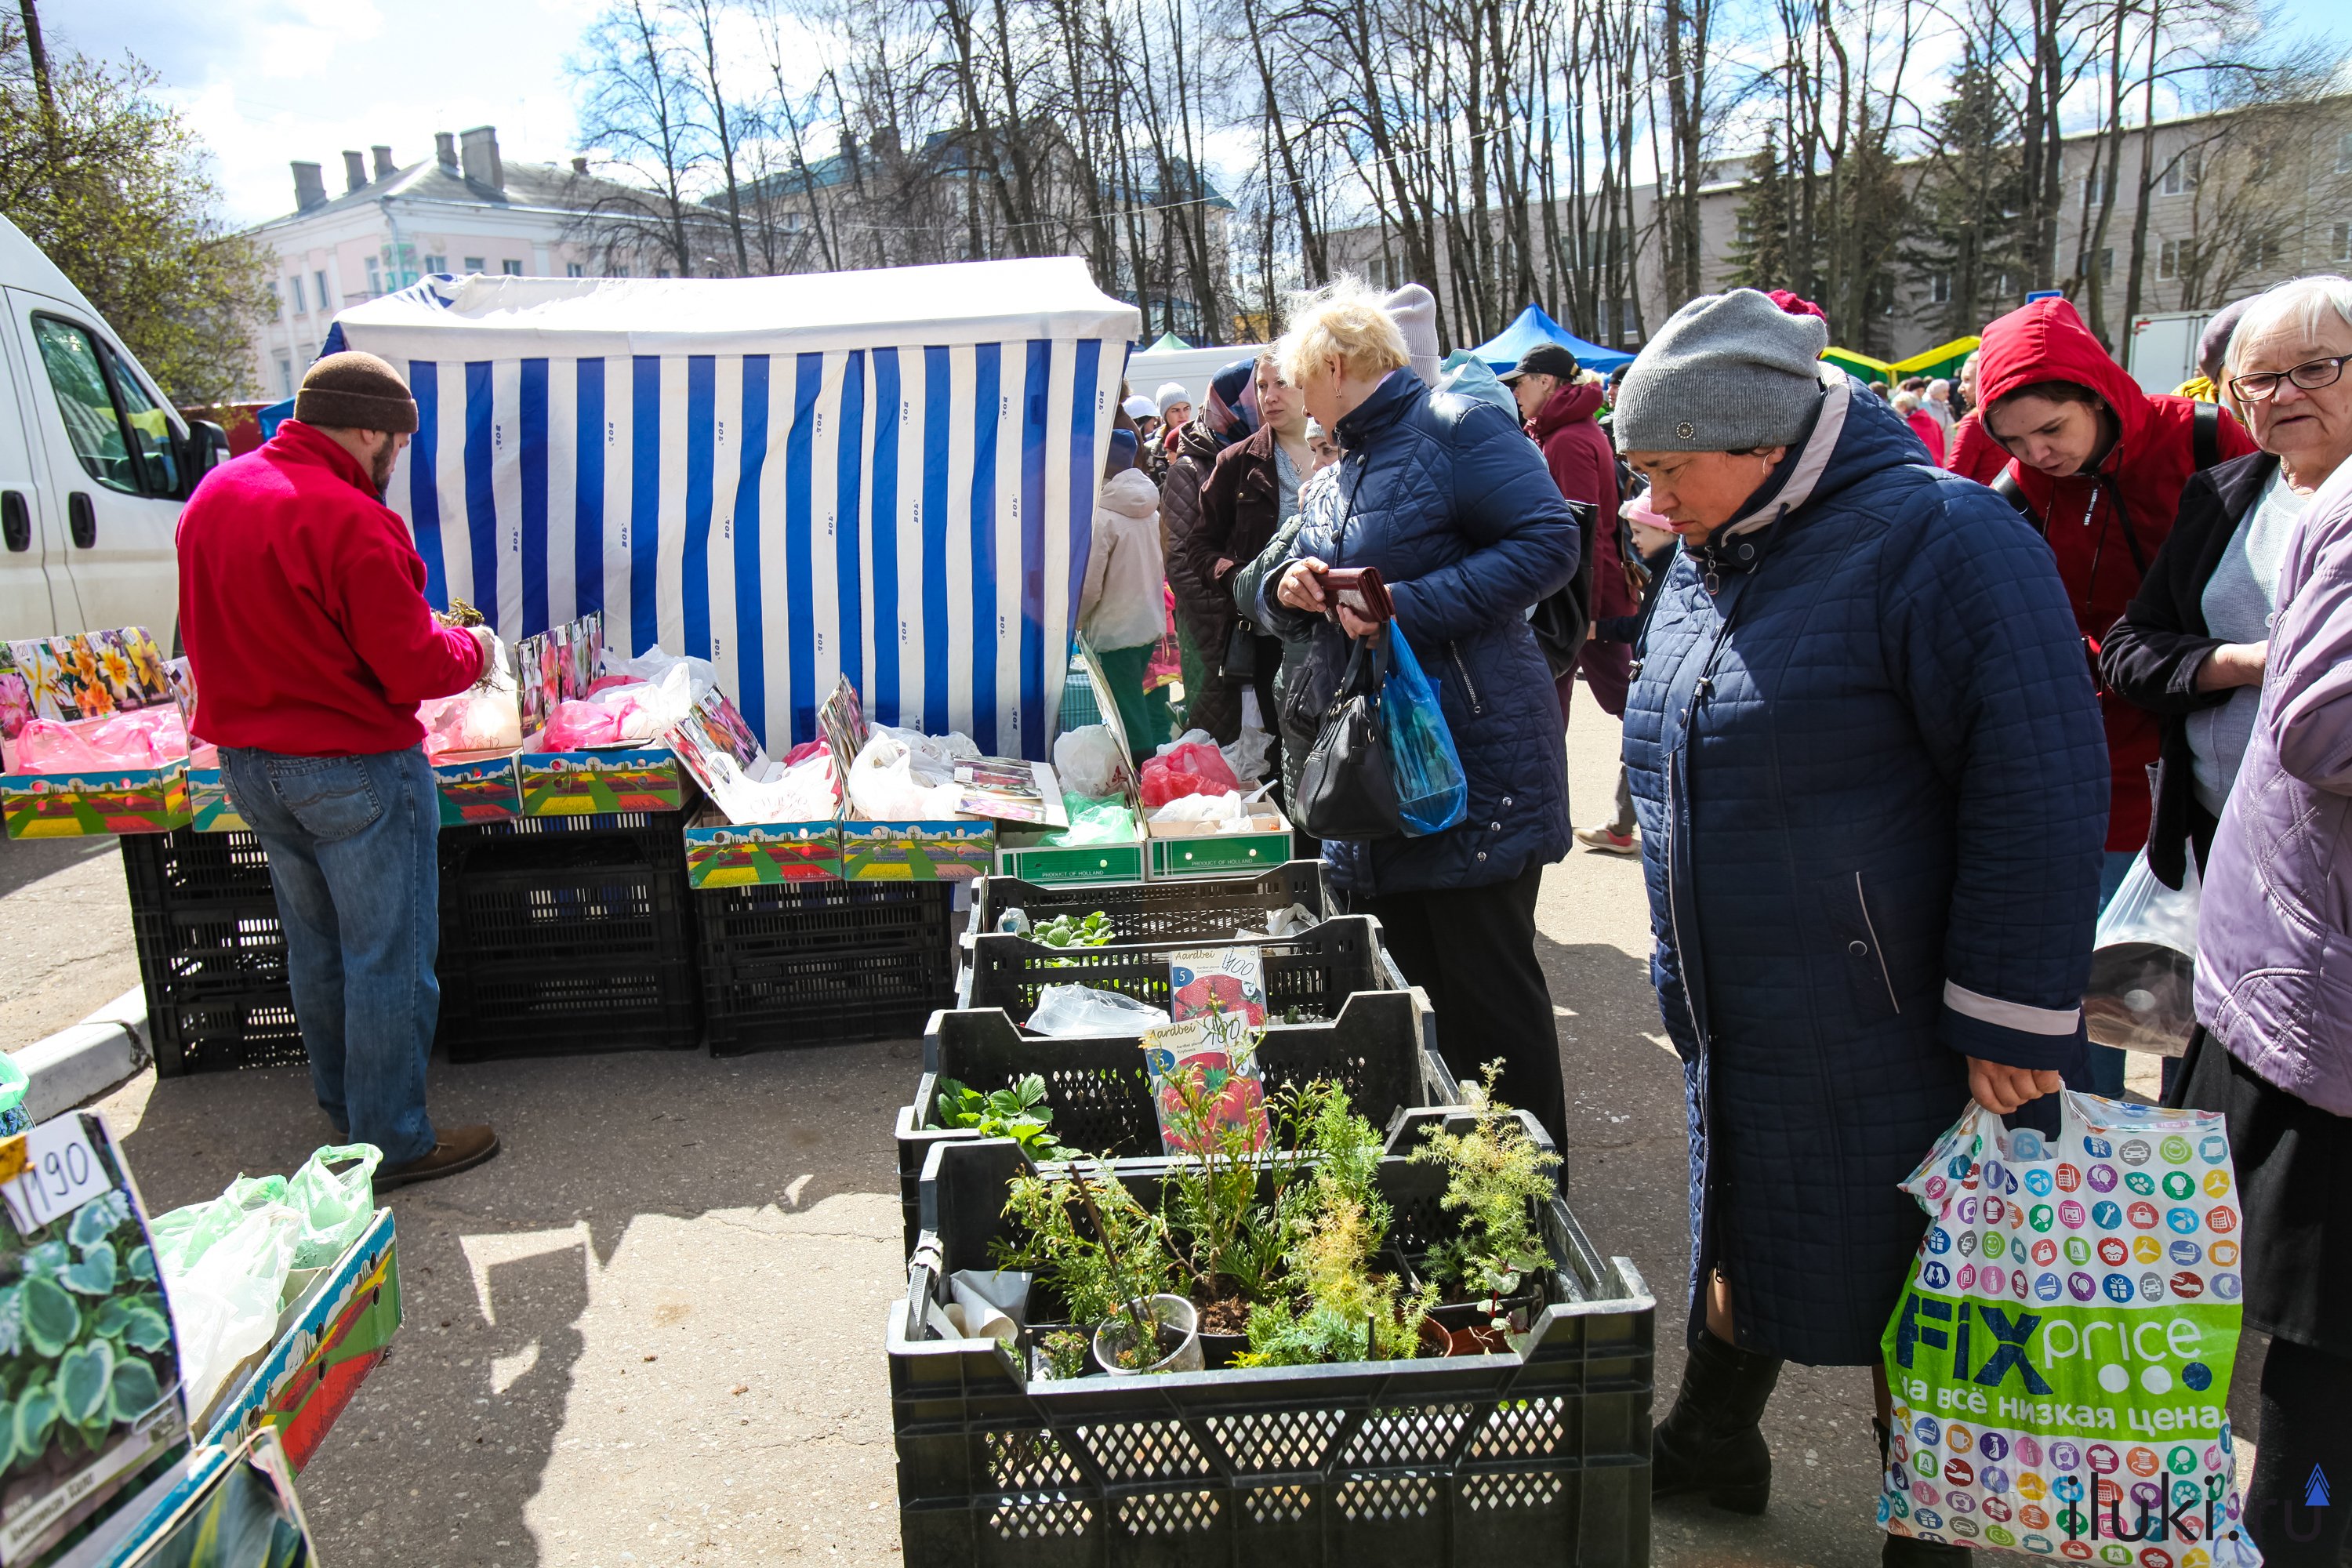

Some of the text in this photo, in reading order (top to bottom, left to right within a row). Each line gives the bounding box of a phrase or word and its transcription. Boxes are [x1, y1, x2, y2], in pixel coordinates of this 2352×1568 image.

[1175, 950, 1216, 960] Aardbei
[1179, 971, 1185, 982] 5
[31, 1142, 89, 1212] 190
[1936, 1387, 1987, 1414] всё
[1998, 1395, 2117, 1430] низкая
[2127, 1405, 2221, 1438] цена
